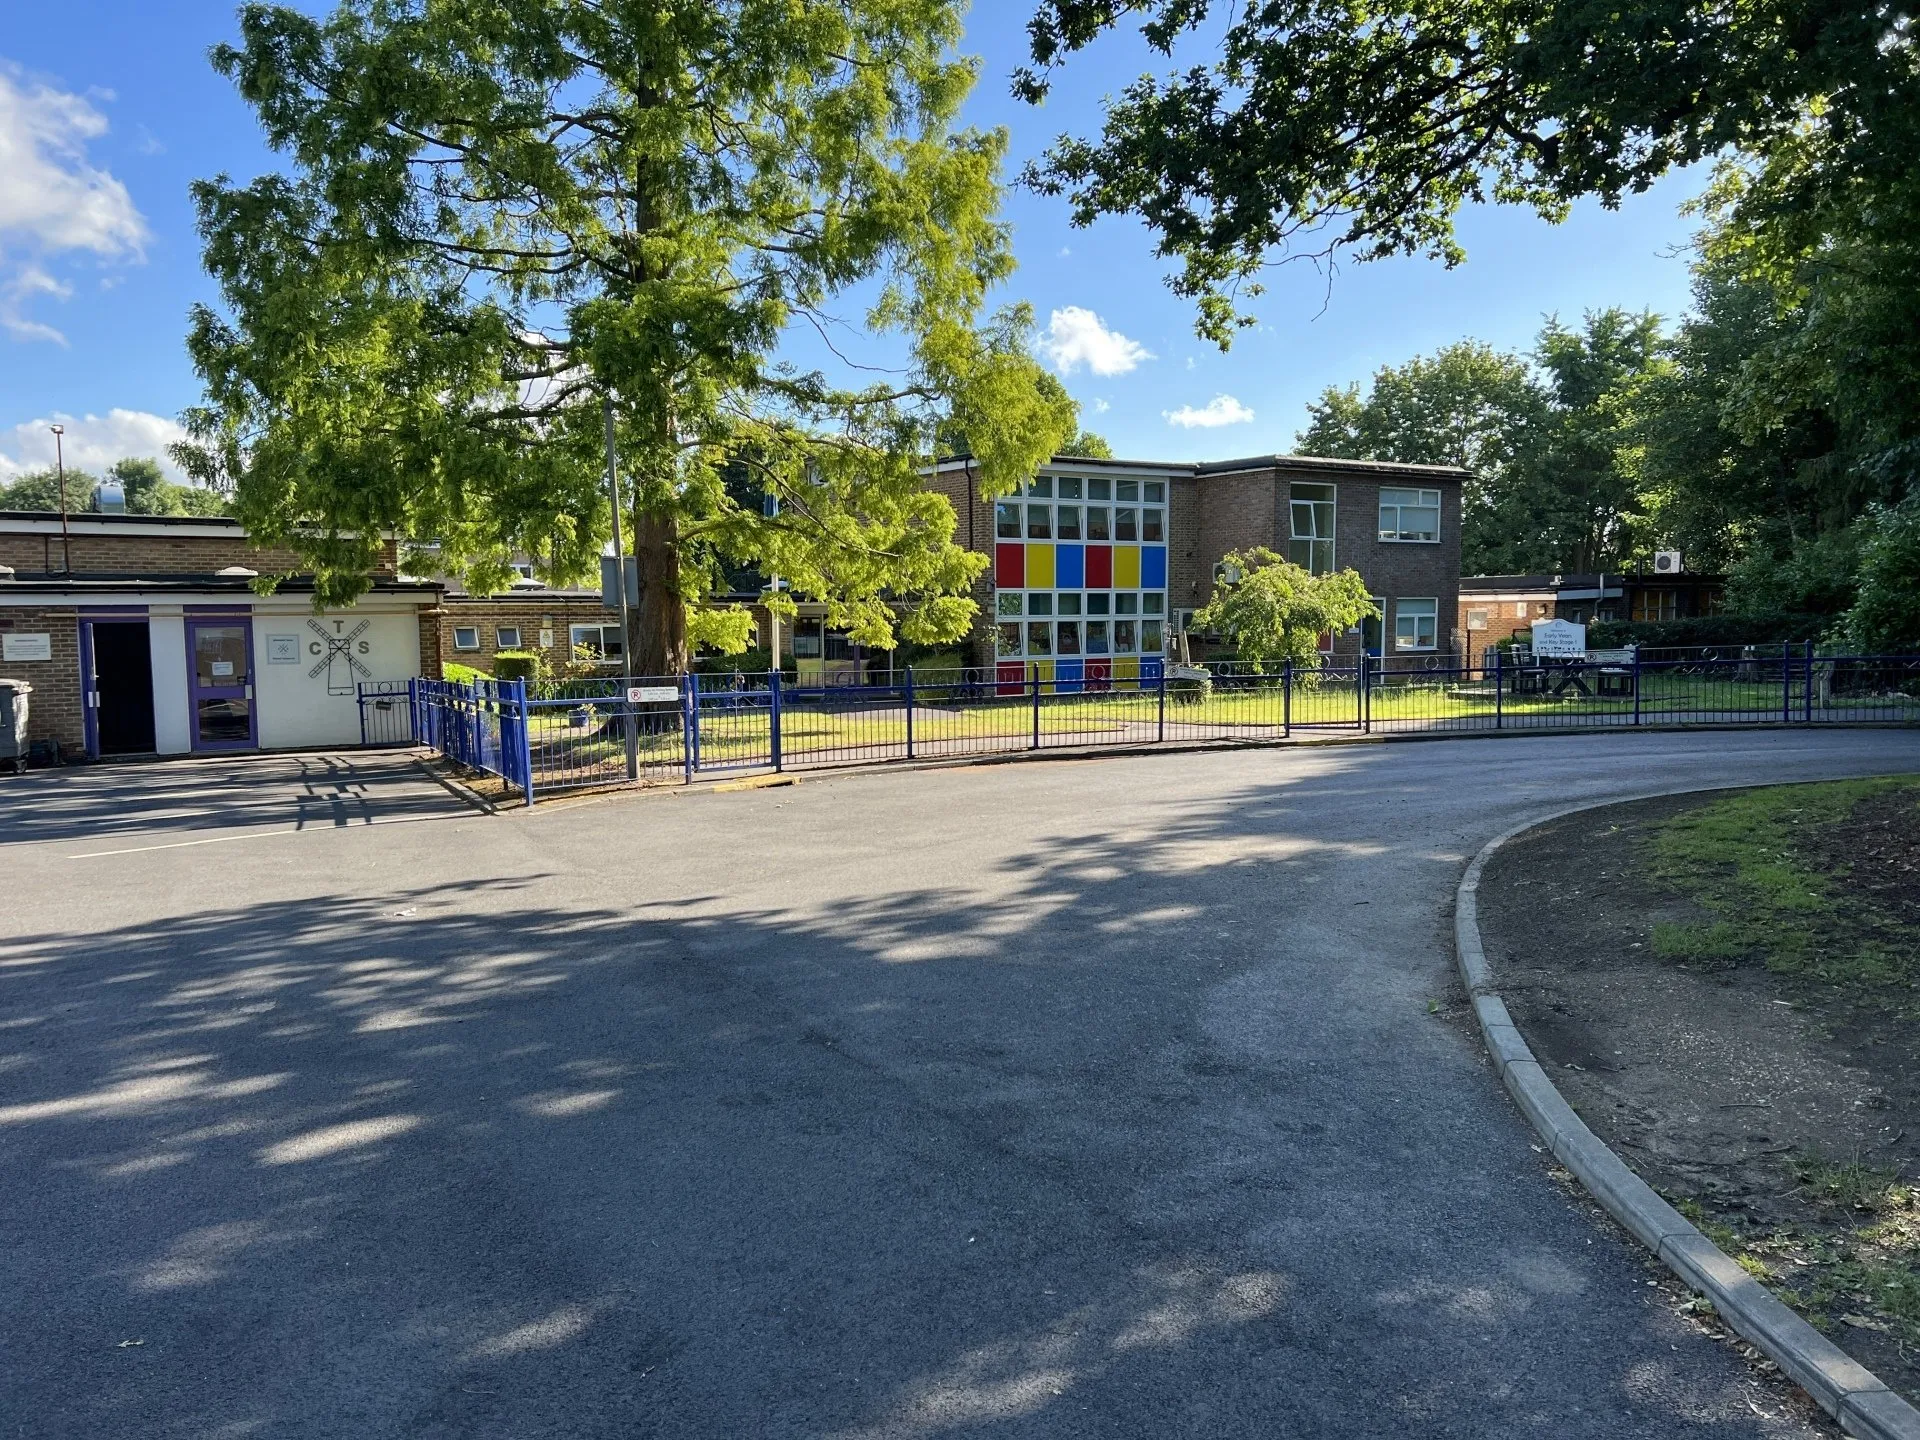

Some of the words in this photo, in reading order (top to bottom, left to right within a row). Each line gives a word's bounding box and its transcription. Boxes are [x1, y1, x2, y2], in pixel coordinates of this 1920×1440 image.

[333, 620, 344, 633] T
[309, 641, 322, 655] C
[358, 641, 369, 654] S
